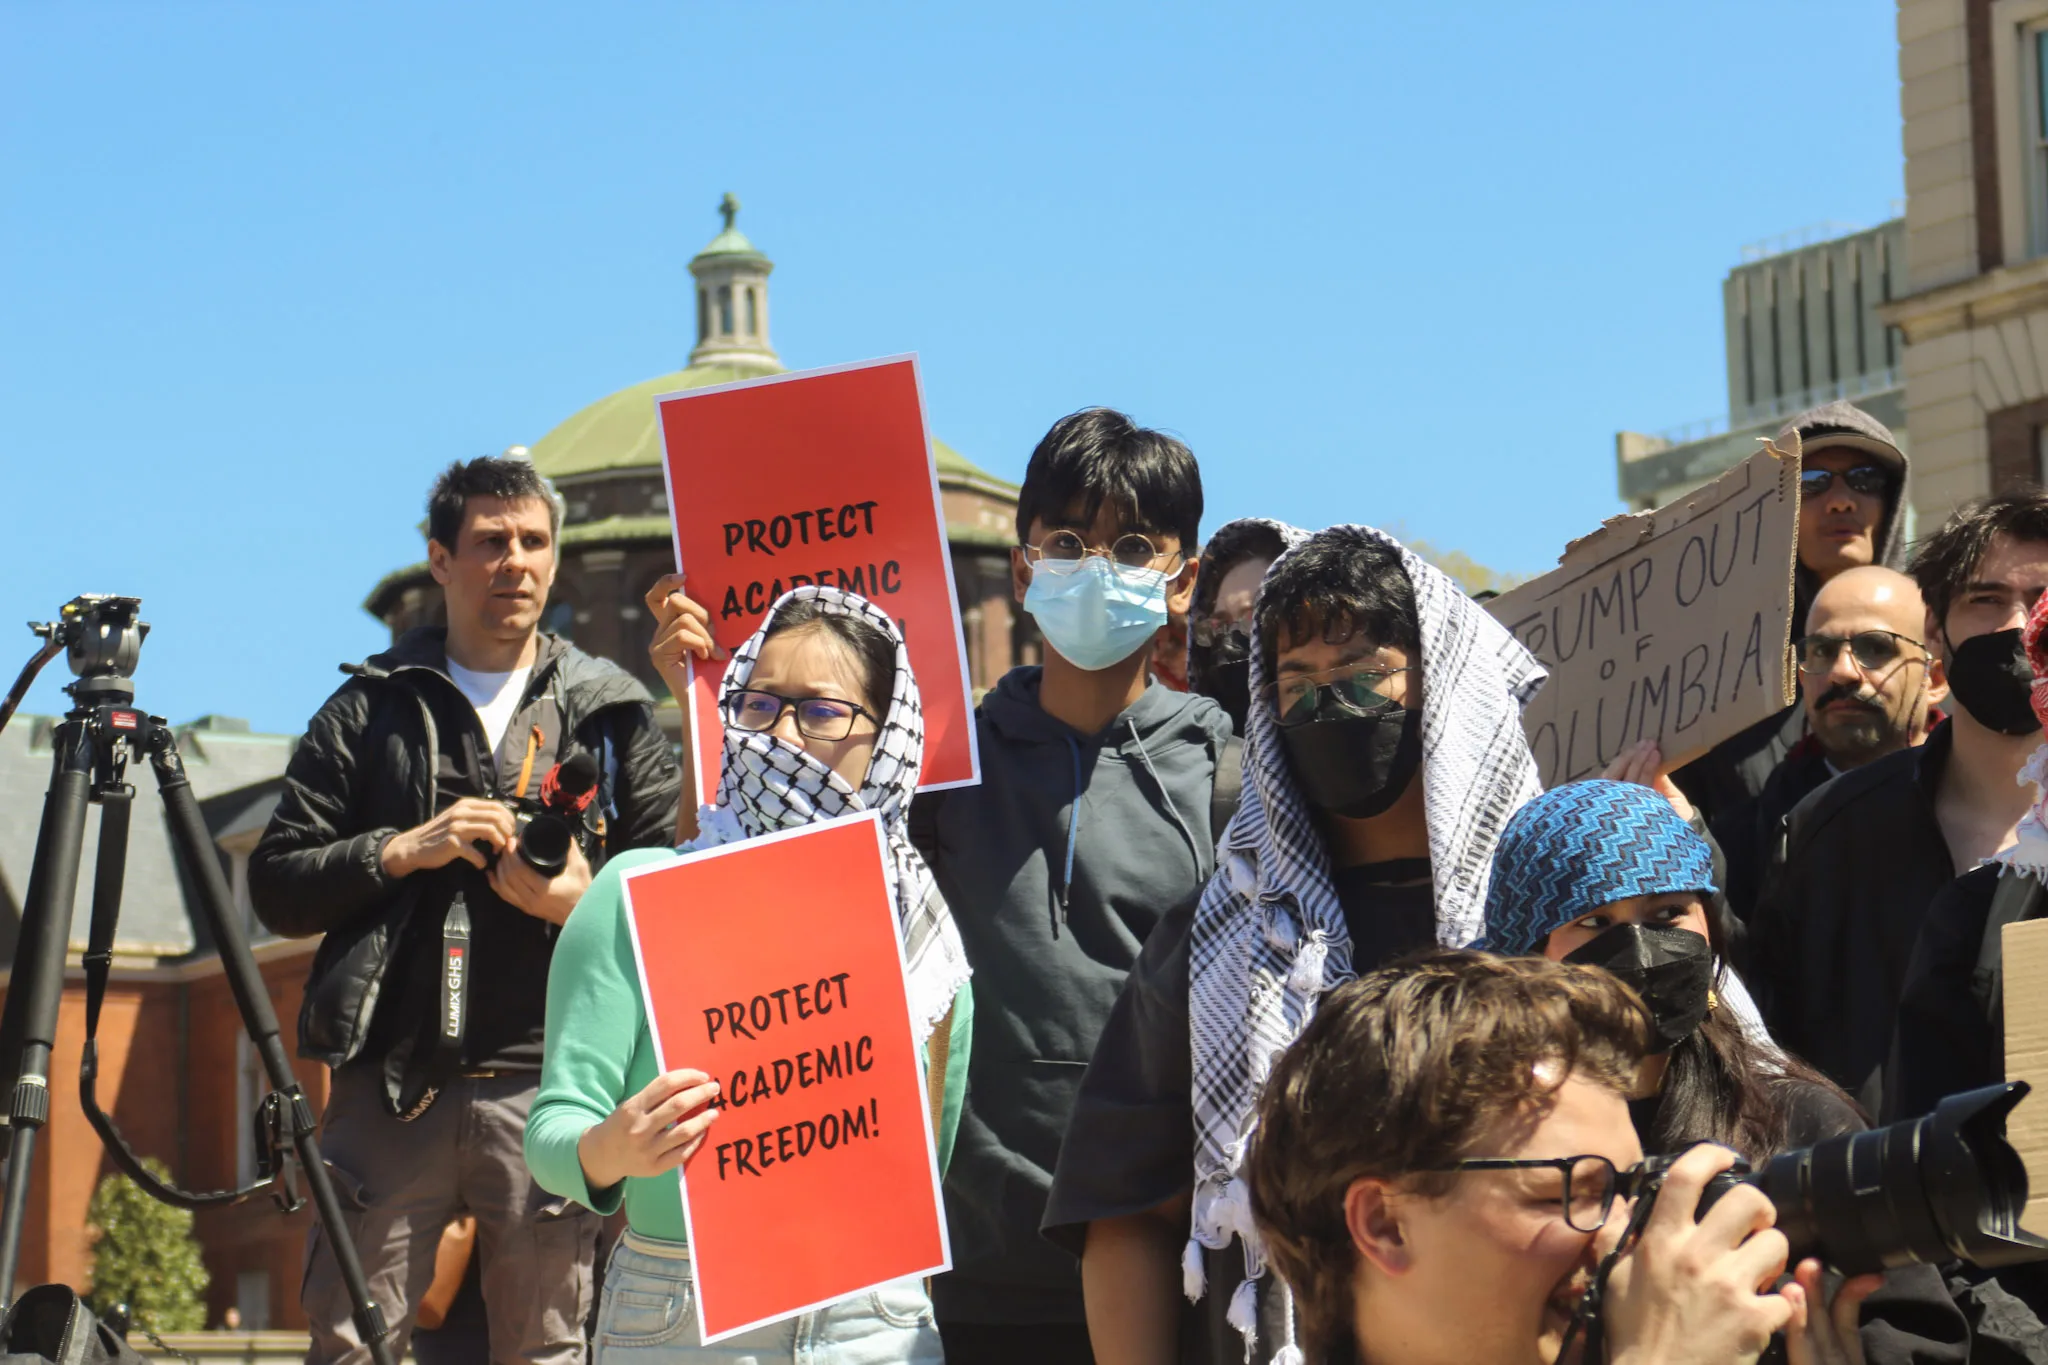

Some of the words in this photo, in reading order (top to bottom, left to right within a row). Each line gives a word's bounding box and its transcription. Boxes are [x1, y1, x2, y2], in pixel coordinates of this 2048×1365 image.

[722, 501, 878, 557] PROTECT
[1676, 488, 1776, 608] OUT
[1600, 634, 1654, 681] OF
[1530, 612, 1763, 792] OLUMBIA
[446, 991, 461, 1038] LUMIX
[702, 972, 850, 1044] PROTECT
[715, 1097, 880, 1181] FREEDOM!
